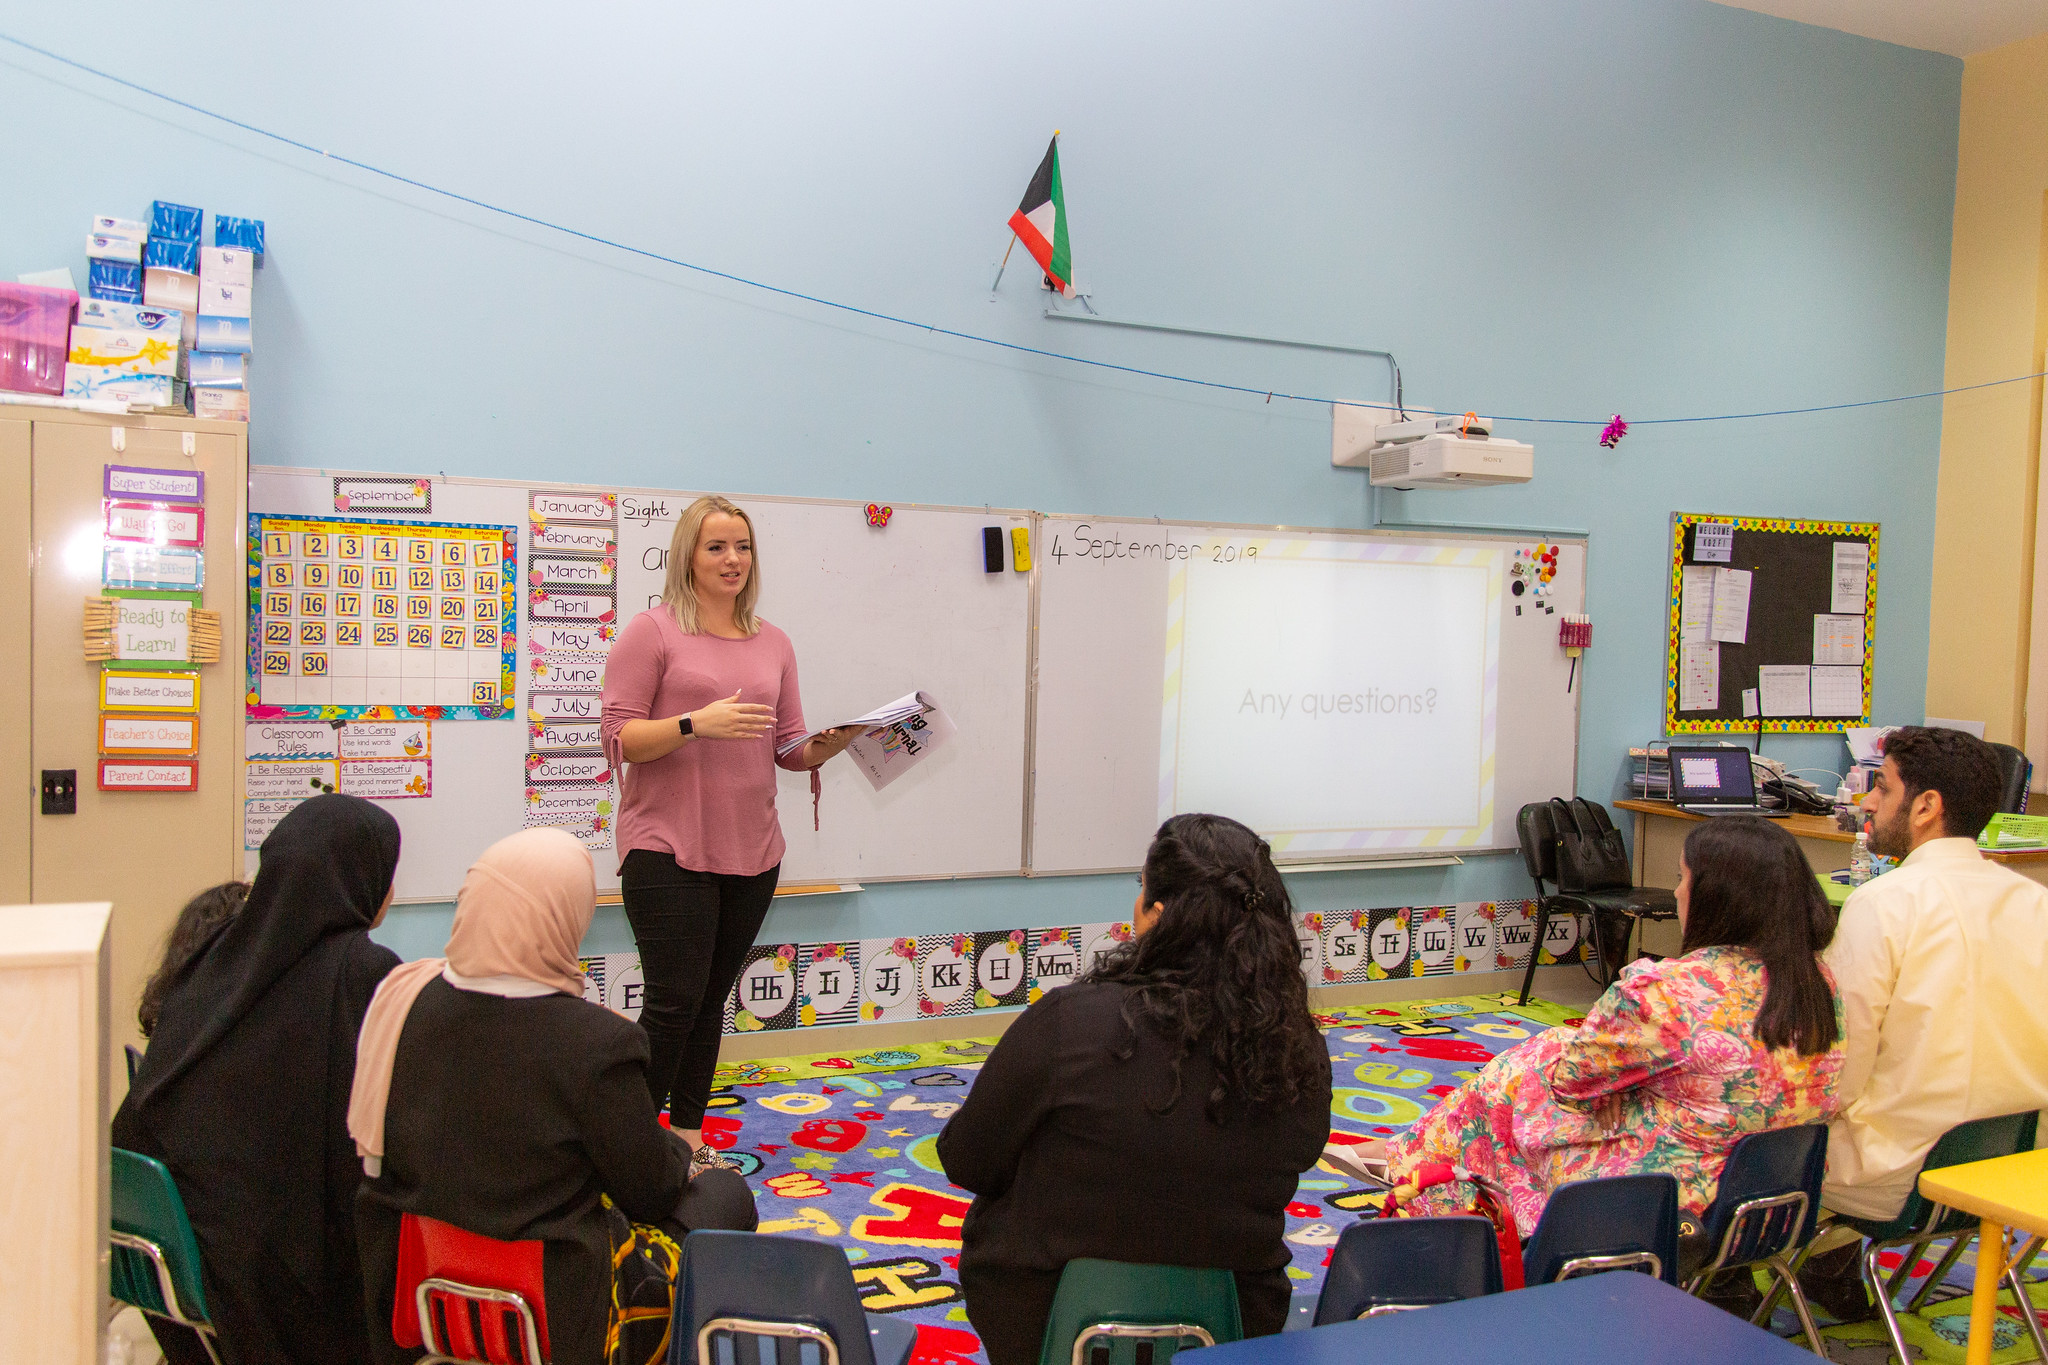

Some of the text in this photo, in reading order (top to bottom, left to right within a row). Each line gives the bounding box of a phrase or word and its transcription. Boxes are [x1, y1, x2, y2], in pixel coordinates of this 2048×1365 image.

[113, 476, 194, 492] Super Student!
[349, 489, 418, 504] September
[539, 500, 605, 517] January
[622, 498, 669, 528] Sight
[122, 516, 146, 533] Way
[168, 519, 186, 532] Go!
[1699, 526, 1730, 536] WELCOME
[275, 538, 490, 562] 1 2 3 4 5 6 7
[1051, 534, 1069, 566] 4
[1074, 524, 1202, 567] September
[276, 568, 493, 590] 8 9 10 11 12 13 14
[547, 564, 597, 579] March
[271, 597, 494, 617] 15 16 17 18 19 20 21
[554, 599, 589, 616] April
[119, 607, 186, 628] Ready to
[126, 634, 176, 652] Learn!
[269, 626, 495, 644] 22 23 24 25 26 27 28
[551, 631, 589, 650] May
[267, 655, 324, 671] 29 30
[551, 667, 597, 683] June
[108, 686, 192, 698] Make Better Choices
[476, 686, 492, 700] 31
[552, 698, 590, 716] July
[1238, 687, 1438, 720] Any questions?
[107, 728, 190, 741] Teacher's Choice
[261, 727, 324, 739] Classroom
[343, 725, 396, 736] 3 Be Caring
[546, 728, 601, 746] August
[892, 722, 922, 756] urnal
[277, 740, 308, 752] Rules
[108, 770, 186, 782] Parent Contact
[258, 765, 270, 774] Be
[274, 765, 324, 776] Responsible
[343, 764, 412, 775] 4 Be Respectful
[540, 763, 597, 777] October
[248, 778, 265, 786] Raise
[268, 779, 284, 787] your
[248, 789, 280, 798] Complete
[538, 796, 599, 809] December
[248, 802, 295, 813] 2 Be Safe
[248, 817, 265, 825] Keep
[1465, 927, 1486, 947] Vv
[1502, 926, 1531, 944] Ww
[1547, 921, 1569, 940] Xx
[1334, 937, 1356, 956] Ss
[1380, 934, 1399, 953] Tt
[1424, 932, 1446, 951] Uu
[990, 959, 1009, 981] Ll
[1037, 955, 1073, 977] Mm
[818, 971, 840, 995] Ii
[876, 968, 900, 996] Jj
[933, 964, 961, 988] Kk
[750, 976, 783, 1001] Hh
